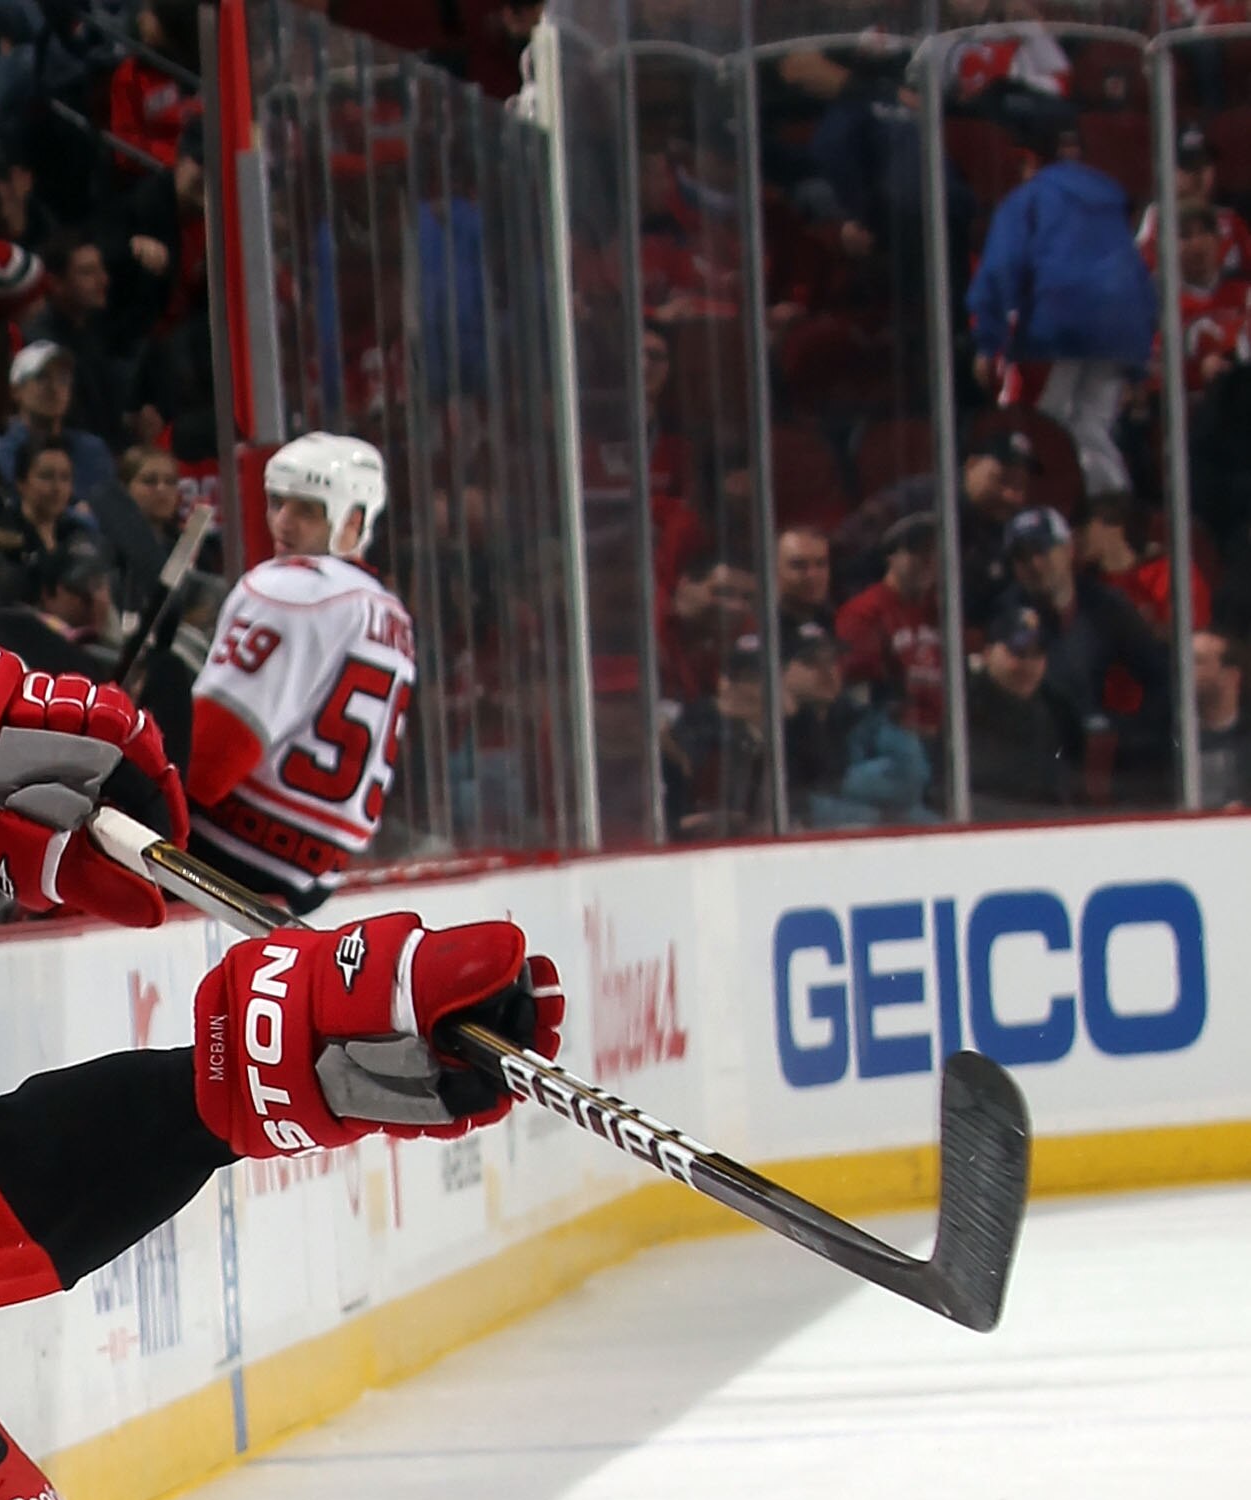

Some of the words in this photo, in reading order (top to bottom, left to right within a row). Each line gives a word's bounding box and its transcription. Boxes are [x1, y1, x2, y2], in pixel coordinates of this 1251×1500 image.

[212, 617, 281, 674] 59
[209, 1014, 228, 1082] MCBAIN
[244, 943, 324, 1158] STON
[772, 878, 1210, 1088] GEICO
